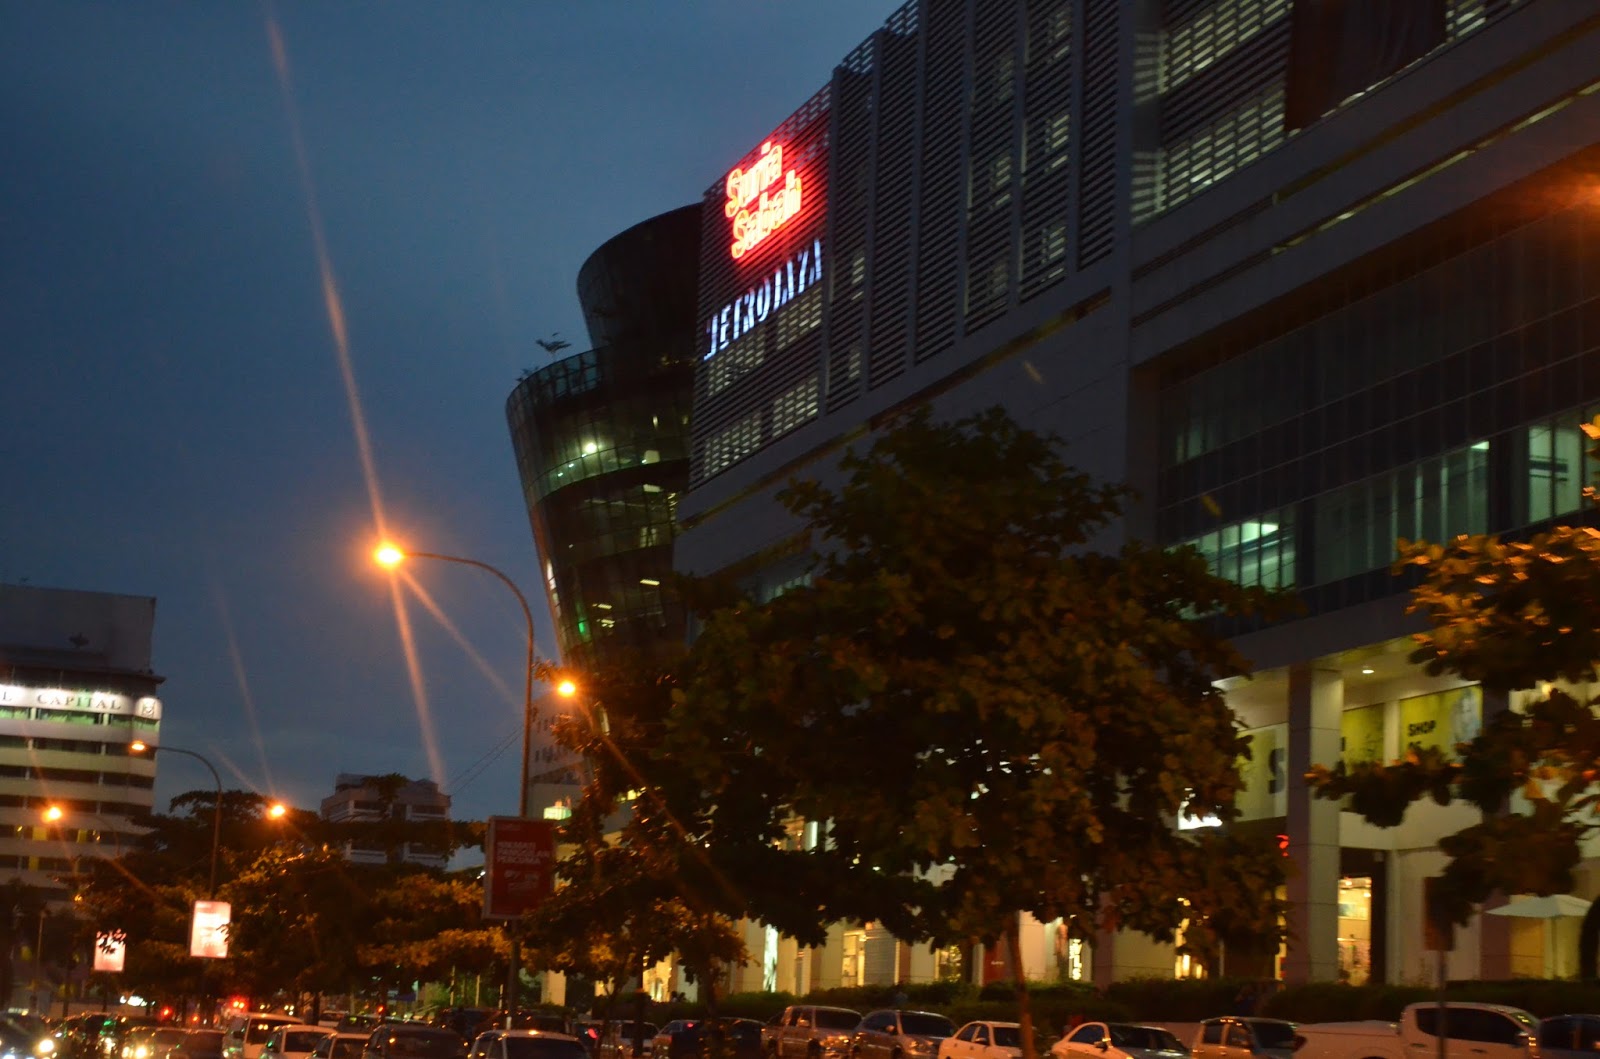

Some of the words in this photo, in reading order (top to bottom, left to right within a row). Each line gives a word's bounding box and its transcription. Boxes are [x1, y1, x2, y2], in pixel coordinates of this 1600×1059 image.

[731, 169, 802, 259] Sabah
[37, 693, 122, 711] CAPITAL
[1407, 719, 1436, 737] SHOP
